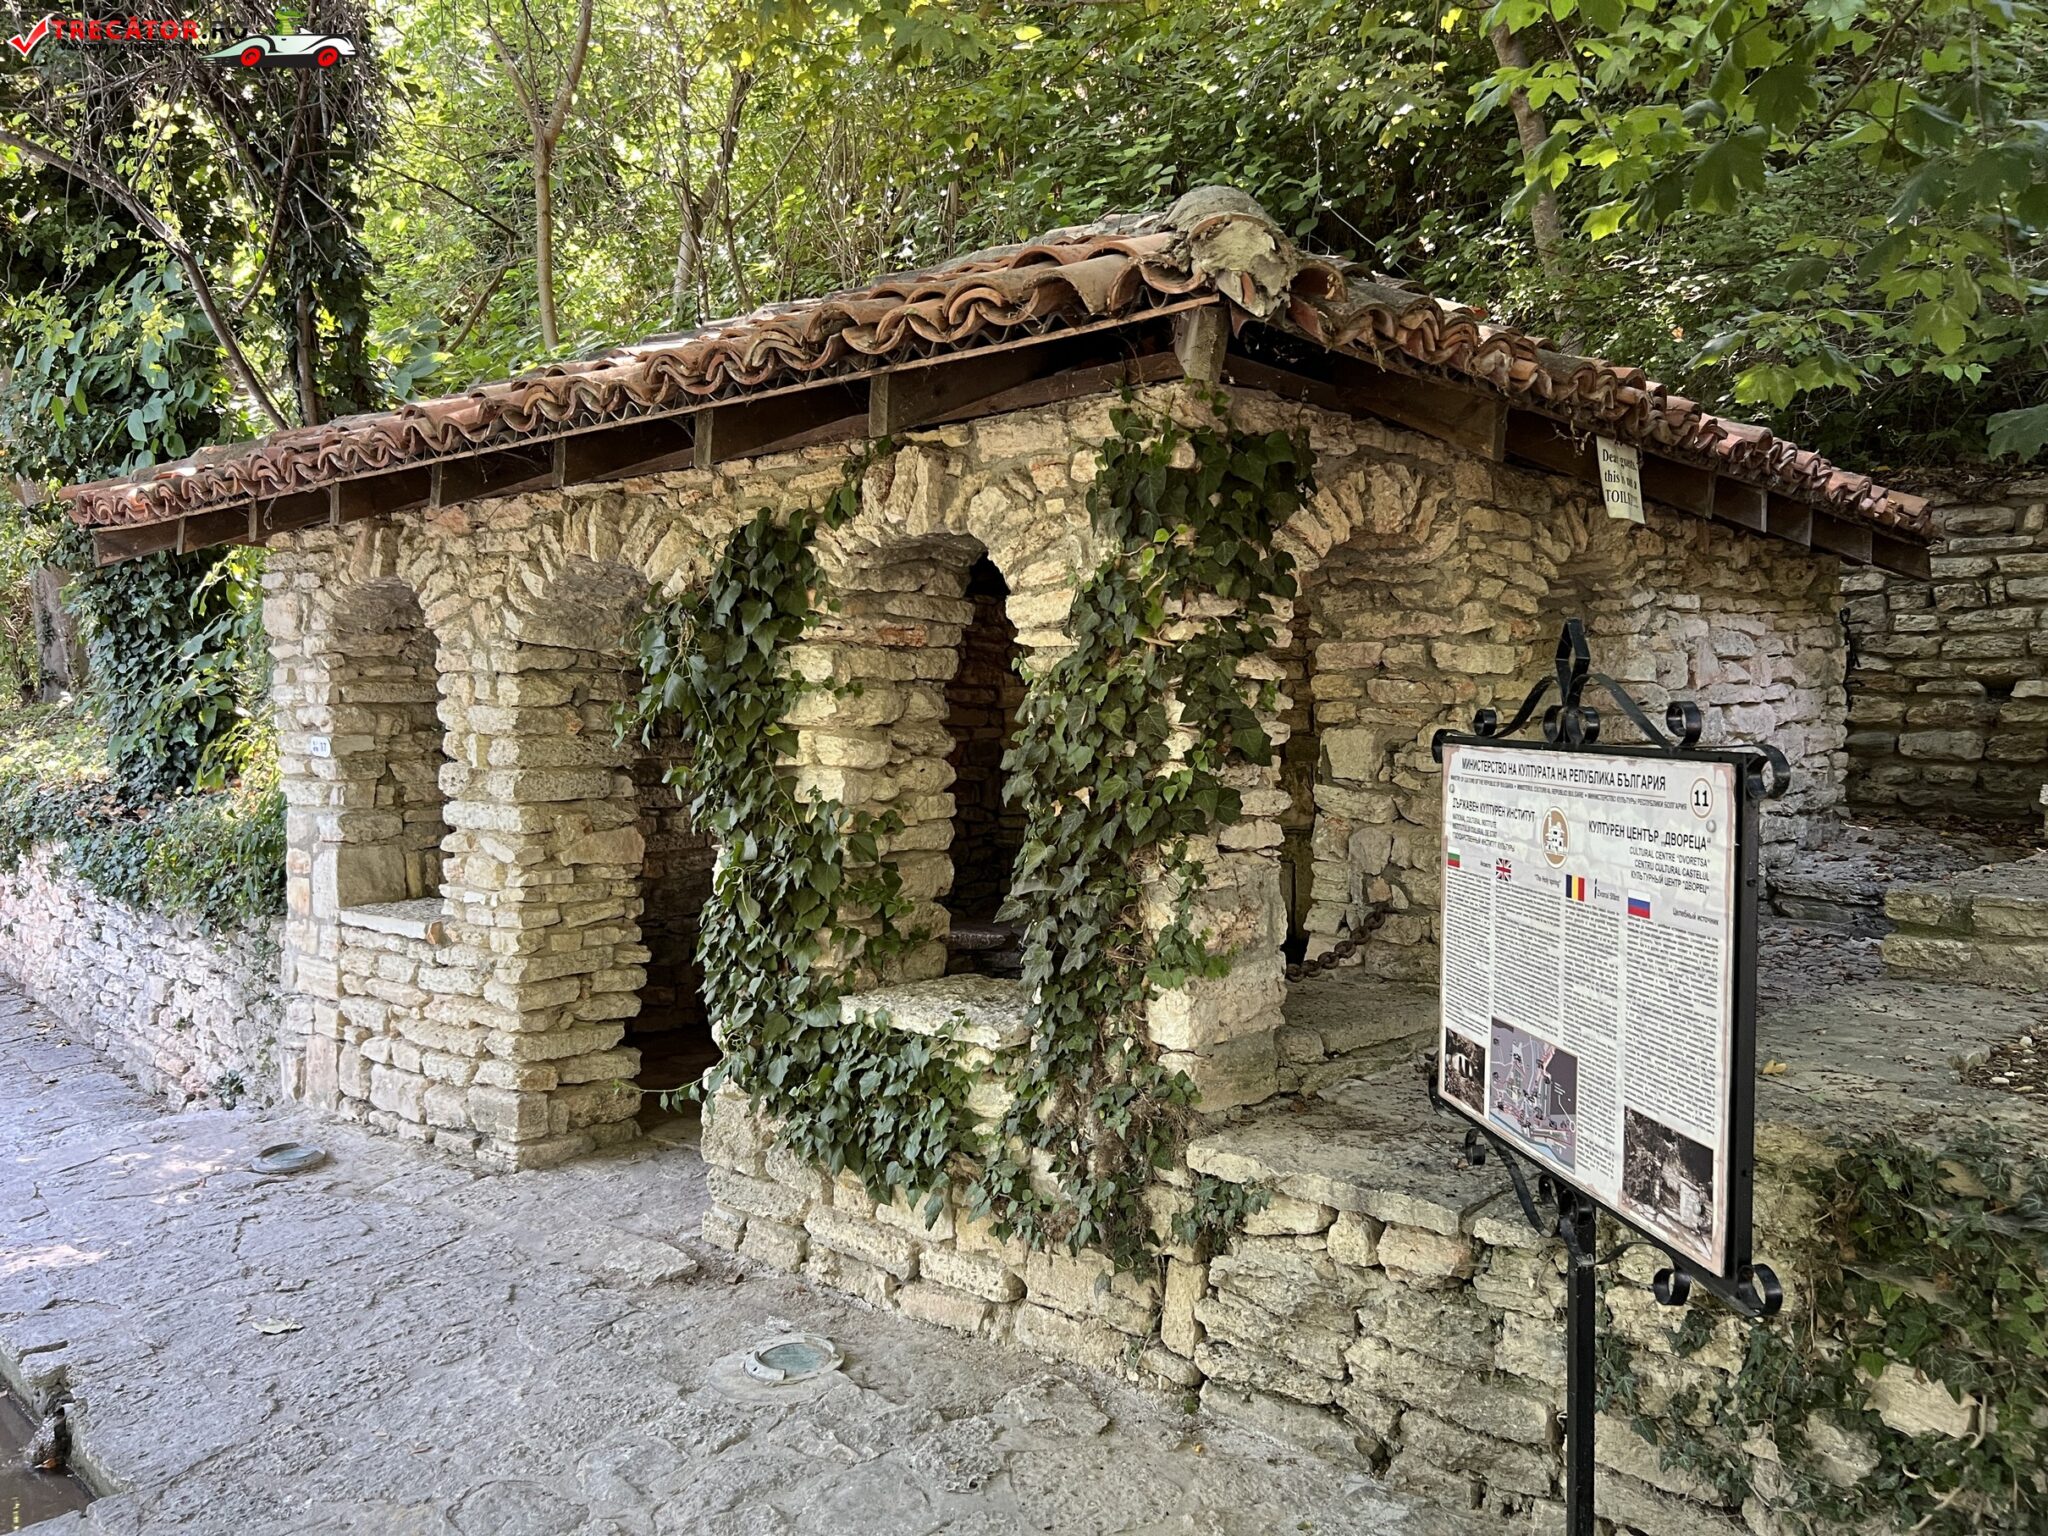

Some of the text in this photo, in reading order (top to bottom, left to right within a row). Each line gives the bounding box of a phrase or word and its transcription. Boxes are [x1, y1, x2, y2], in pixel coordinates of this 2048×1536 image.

[1604, 470, 1620, 483] this
[1462, 758, 1666, 791] МИНИСТЕРСТВО НА КУЛТУРАТА НА РЕПУБЛИКА БЪЛГАРИЯ
[1694, 790, 1709, 807] 11
[1588, 820, 1625, 838] КУЛТУРЕН
[1626, 827, 1659, 843] ЦЕНТЪР
[1629, 846, 1654, 859] CULTURAL
[1655, 850, 1675, 862] CENTRE
[1631, 870, 1664, 884] КУЛЬТУРНЫЙ
[1664, 876, 1681, 888] ЦЕНТР
[1634, 859, 1710, 882] CENTRU CULTURAL CASTELUL
